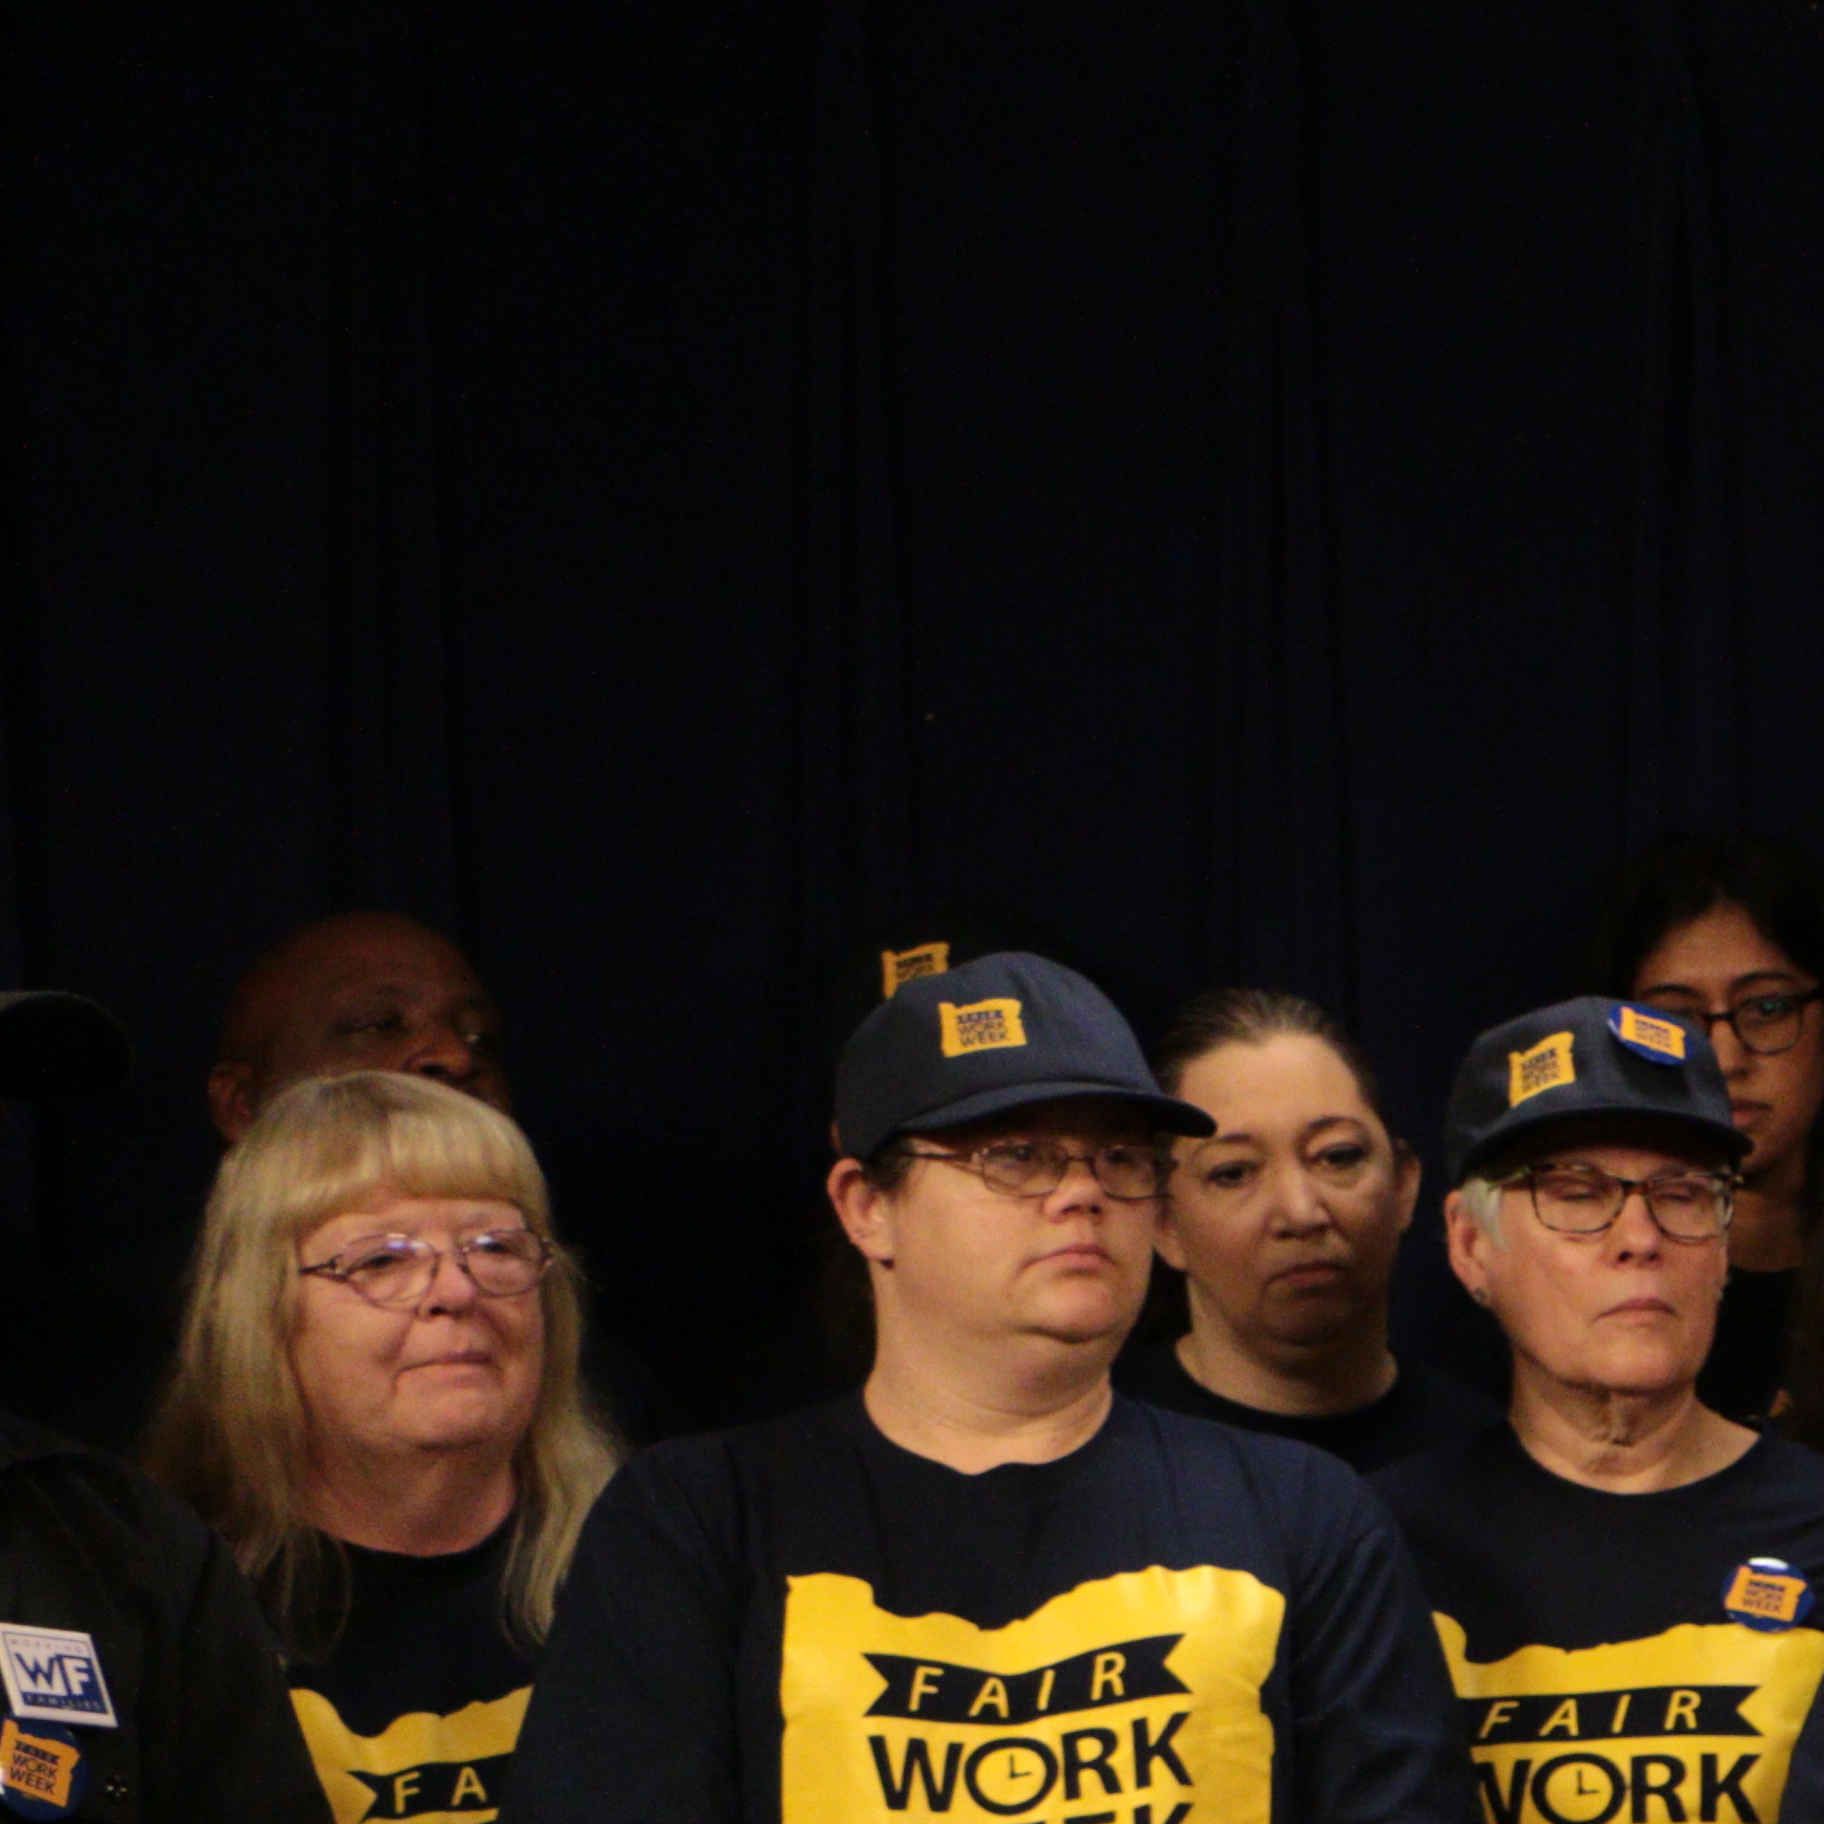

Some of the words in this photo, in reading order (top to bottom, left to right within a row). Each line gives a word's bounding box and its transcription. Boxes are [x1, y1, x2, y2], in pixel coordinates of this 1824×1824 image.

[15, 1653, 90, 1697] WF
[908, 1652, 1126, 1718] FAIR
[1478, 1689, 1701, 1739] FAIR
[10, 1766, 55, 1795] WEEK
[12, 1752, 57, 1780] WORK
[868, 1712, 1193, 1816] WORK
[394, 1766, 489, 1815] FA
